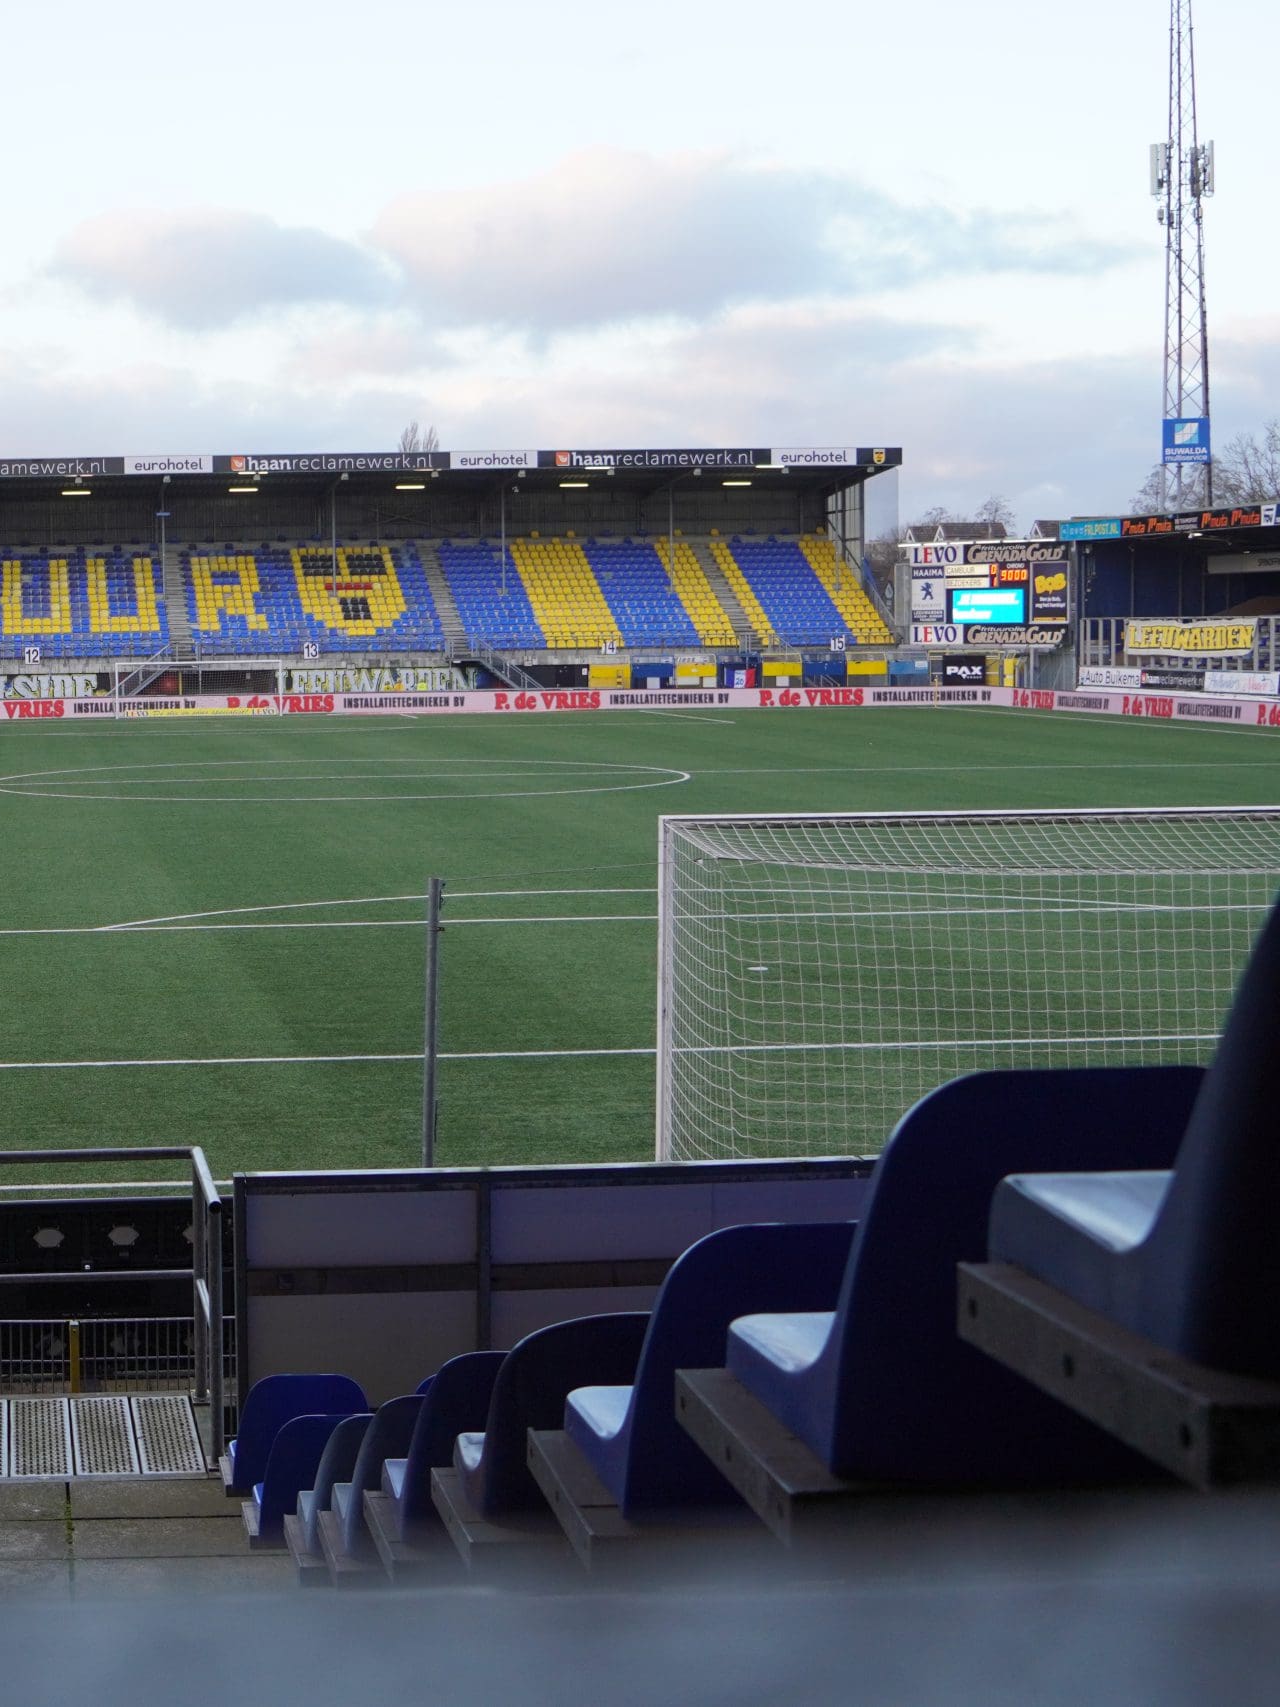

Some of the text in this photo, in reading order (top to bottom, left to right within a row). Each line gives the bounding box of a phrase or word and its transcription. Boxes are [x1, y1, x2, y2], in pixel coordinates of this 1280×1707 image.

[134, 457, 203, 471] eurohotel
[247, 453, 433, 471] haanreclamewerk.nl
[460, 453, 528, 466] eurohotel
[572, 450, 754, 467] haanreclamewerk.nl
[780, 450, 848, 463] eurohotel
[913, 546, 957, 563] LEVO
[913, 569, 943, 577] HAAIMA
[913, 626, 957, 643] LEVO
[1128, 624, 1255, 650] LEEUWARDEN
[305, 643, 319, 658] 13
[832, 636, 844, 650] 15
[25, 649, 40, 664] 12
[946, 666, 982, 675] PAX
[273, 694, 335, 713] VRIES
[343, 696, 465, 708] INSTALLATIETECHNIEKEN BV
[494, 691, 601, 710] P. de VRIES
[609, 693, 729, 706] INSTALLATIETECHNIEKEN BV
[759, 688, 864, 706] P. de VRIES
[981, 690, 992, 701] BV
[1021, 691, 1030, 708] de
[1030, 689, 1055, 711] VRIES
[3, 700, 65, 719] VRIES
[1122, 696, 1174, 718] P. de VRIES
